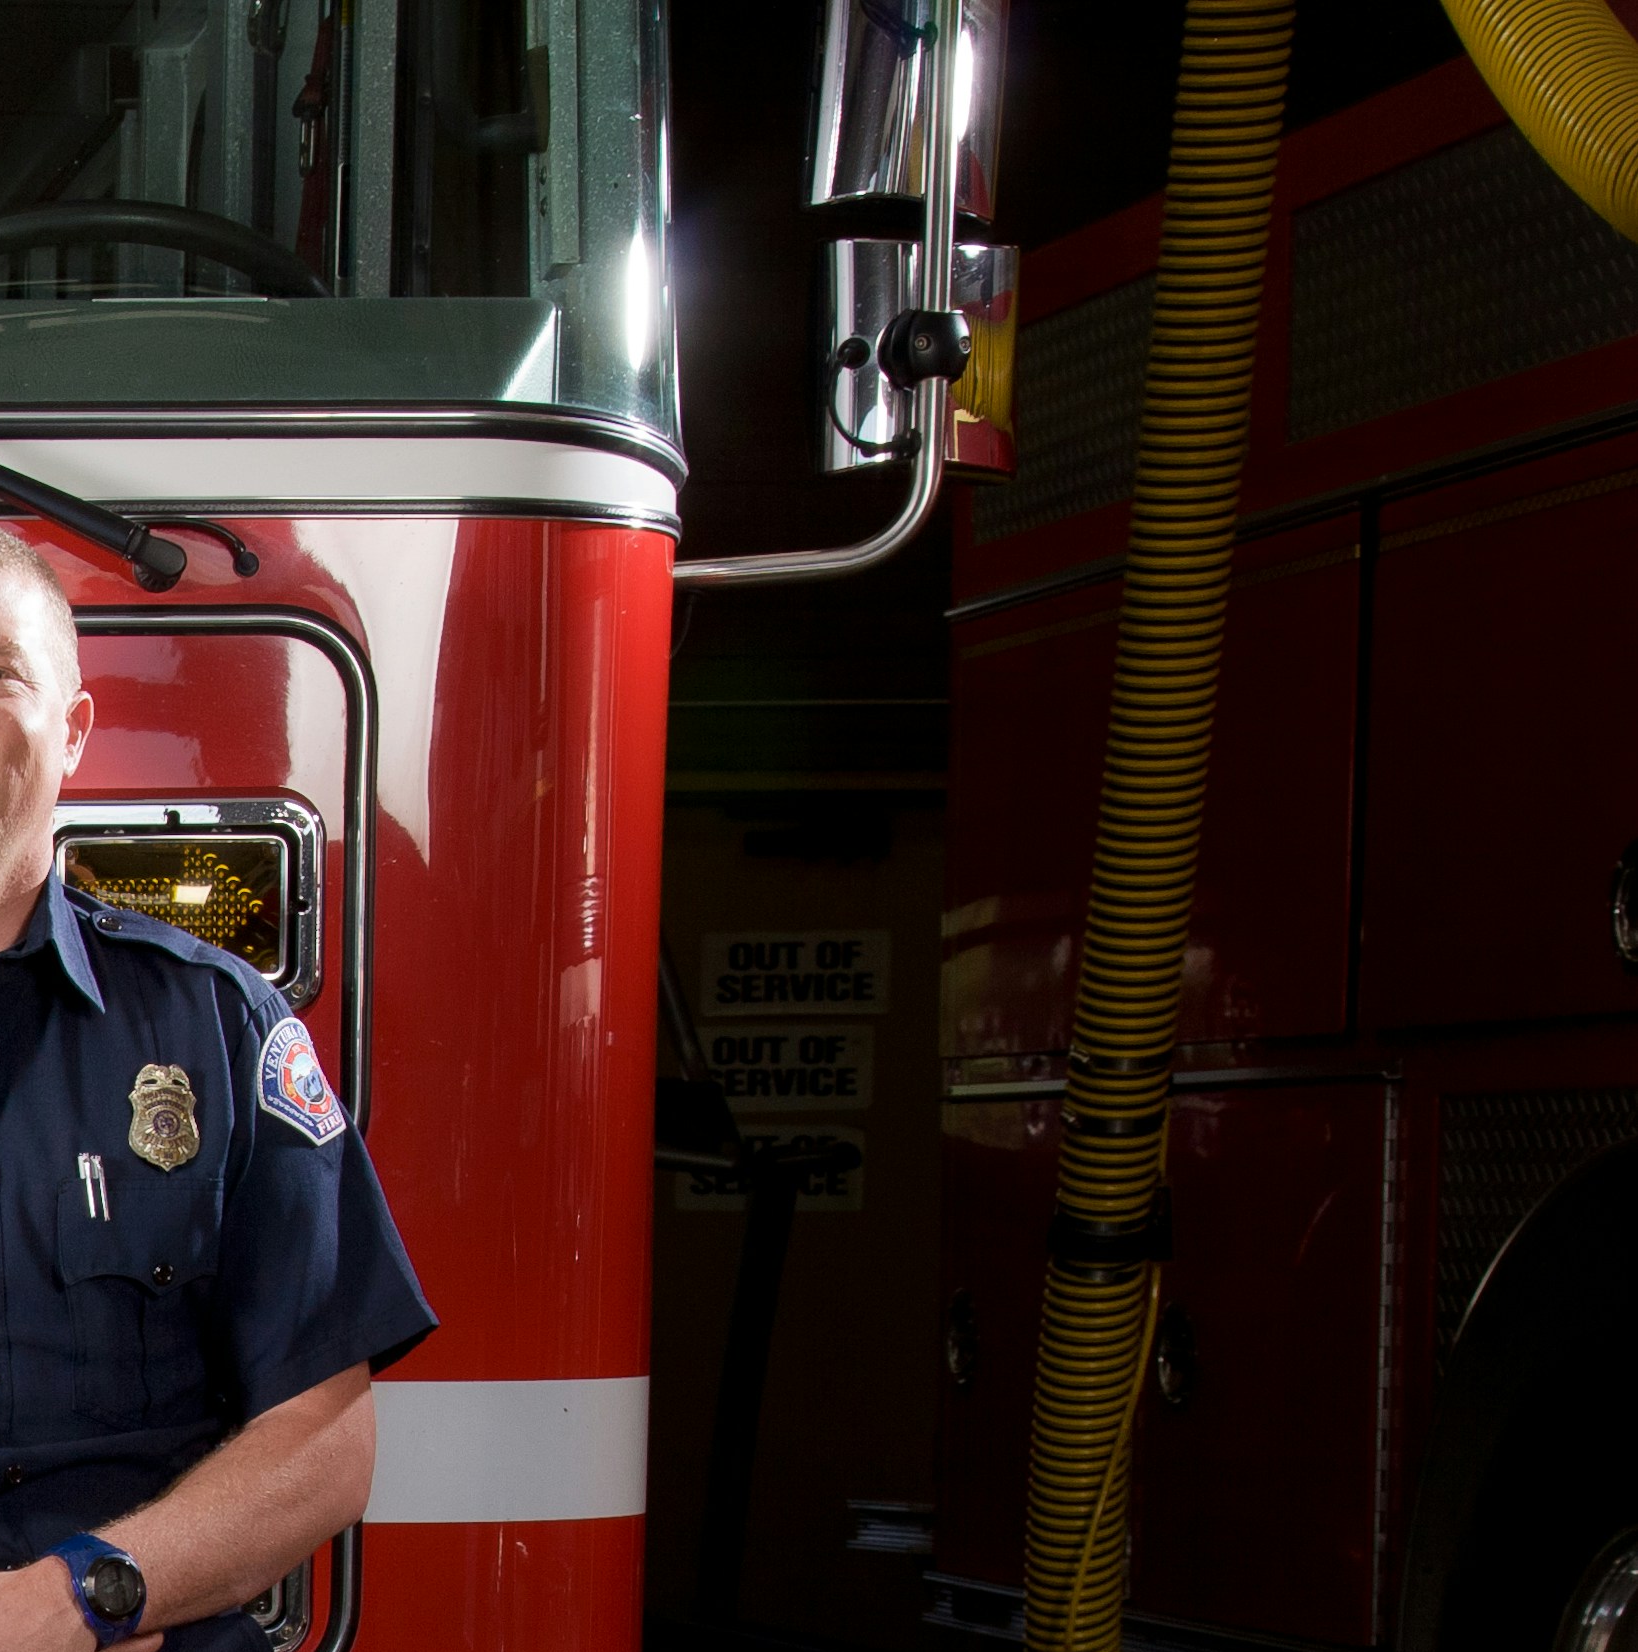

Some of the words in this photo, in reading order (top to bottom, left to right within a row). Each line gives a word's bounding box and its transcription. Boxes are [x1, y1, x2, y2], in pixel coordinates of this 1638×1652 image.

[728, 942, 805, 970] OUT
[816, 940, 864, 969] OF
[716, 973, 875, 1003] SERVICE
[713, 1036, 788, 1065] OUT
[799, 1036, 846, 1064] OF
[316, 1111, 342, 1136] FIRE
